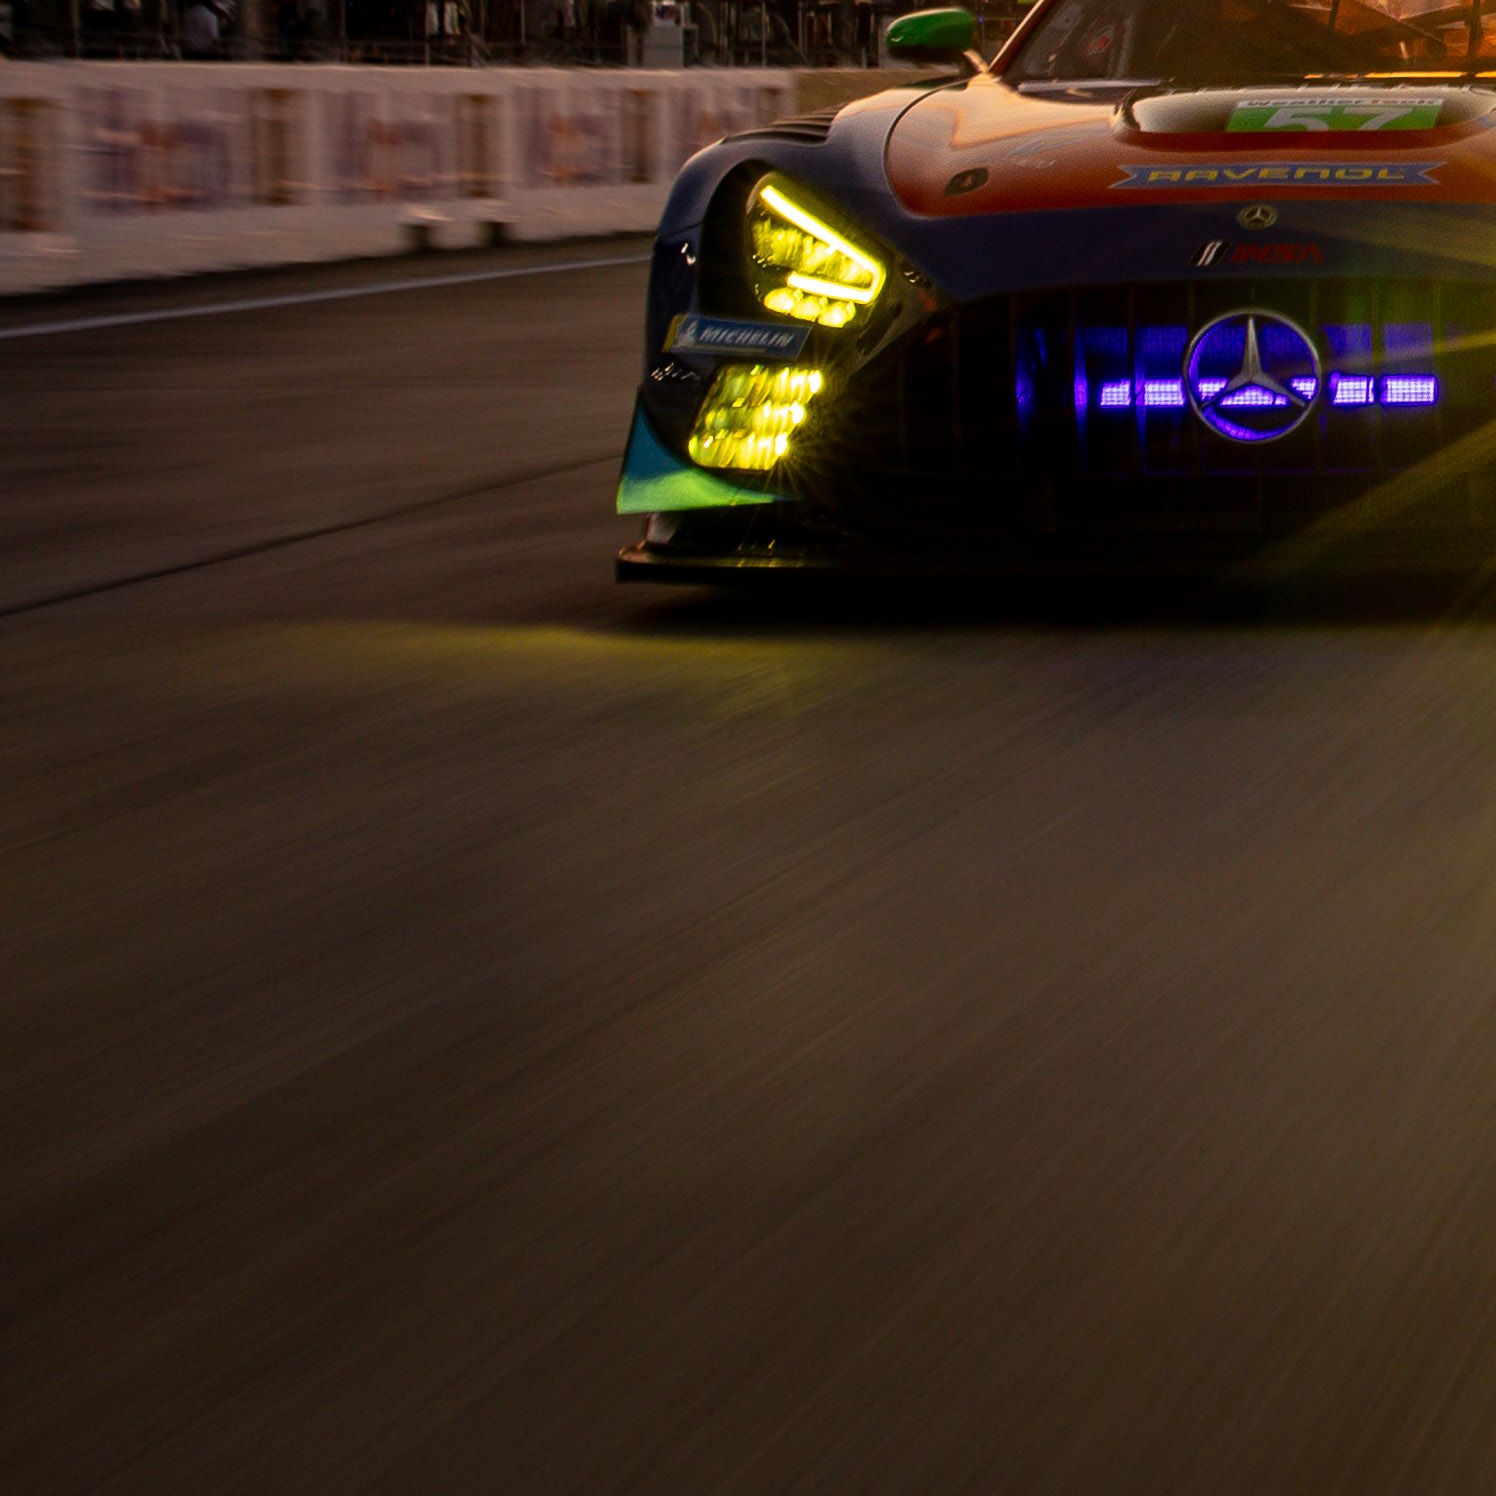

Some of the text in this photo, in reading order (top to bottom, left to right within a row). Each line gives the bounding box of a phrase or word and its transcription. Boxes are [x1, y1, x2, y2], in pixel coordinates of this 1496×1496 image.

[1147, 167, 1406, 183] RAVENOL
[1230, 242, 1323, 265] IMSA
[700, 325, 796, 348] MICHELIN
